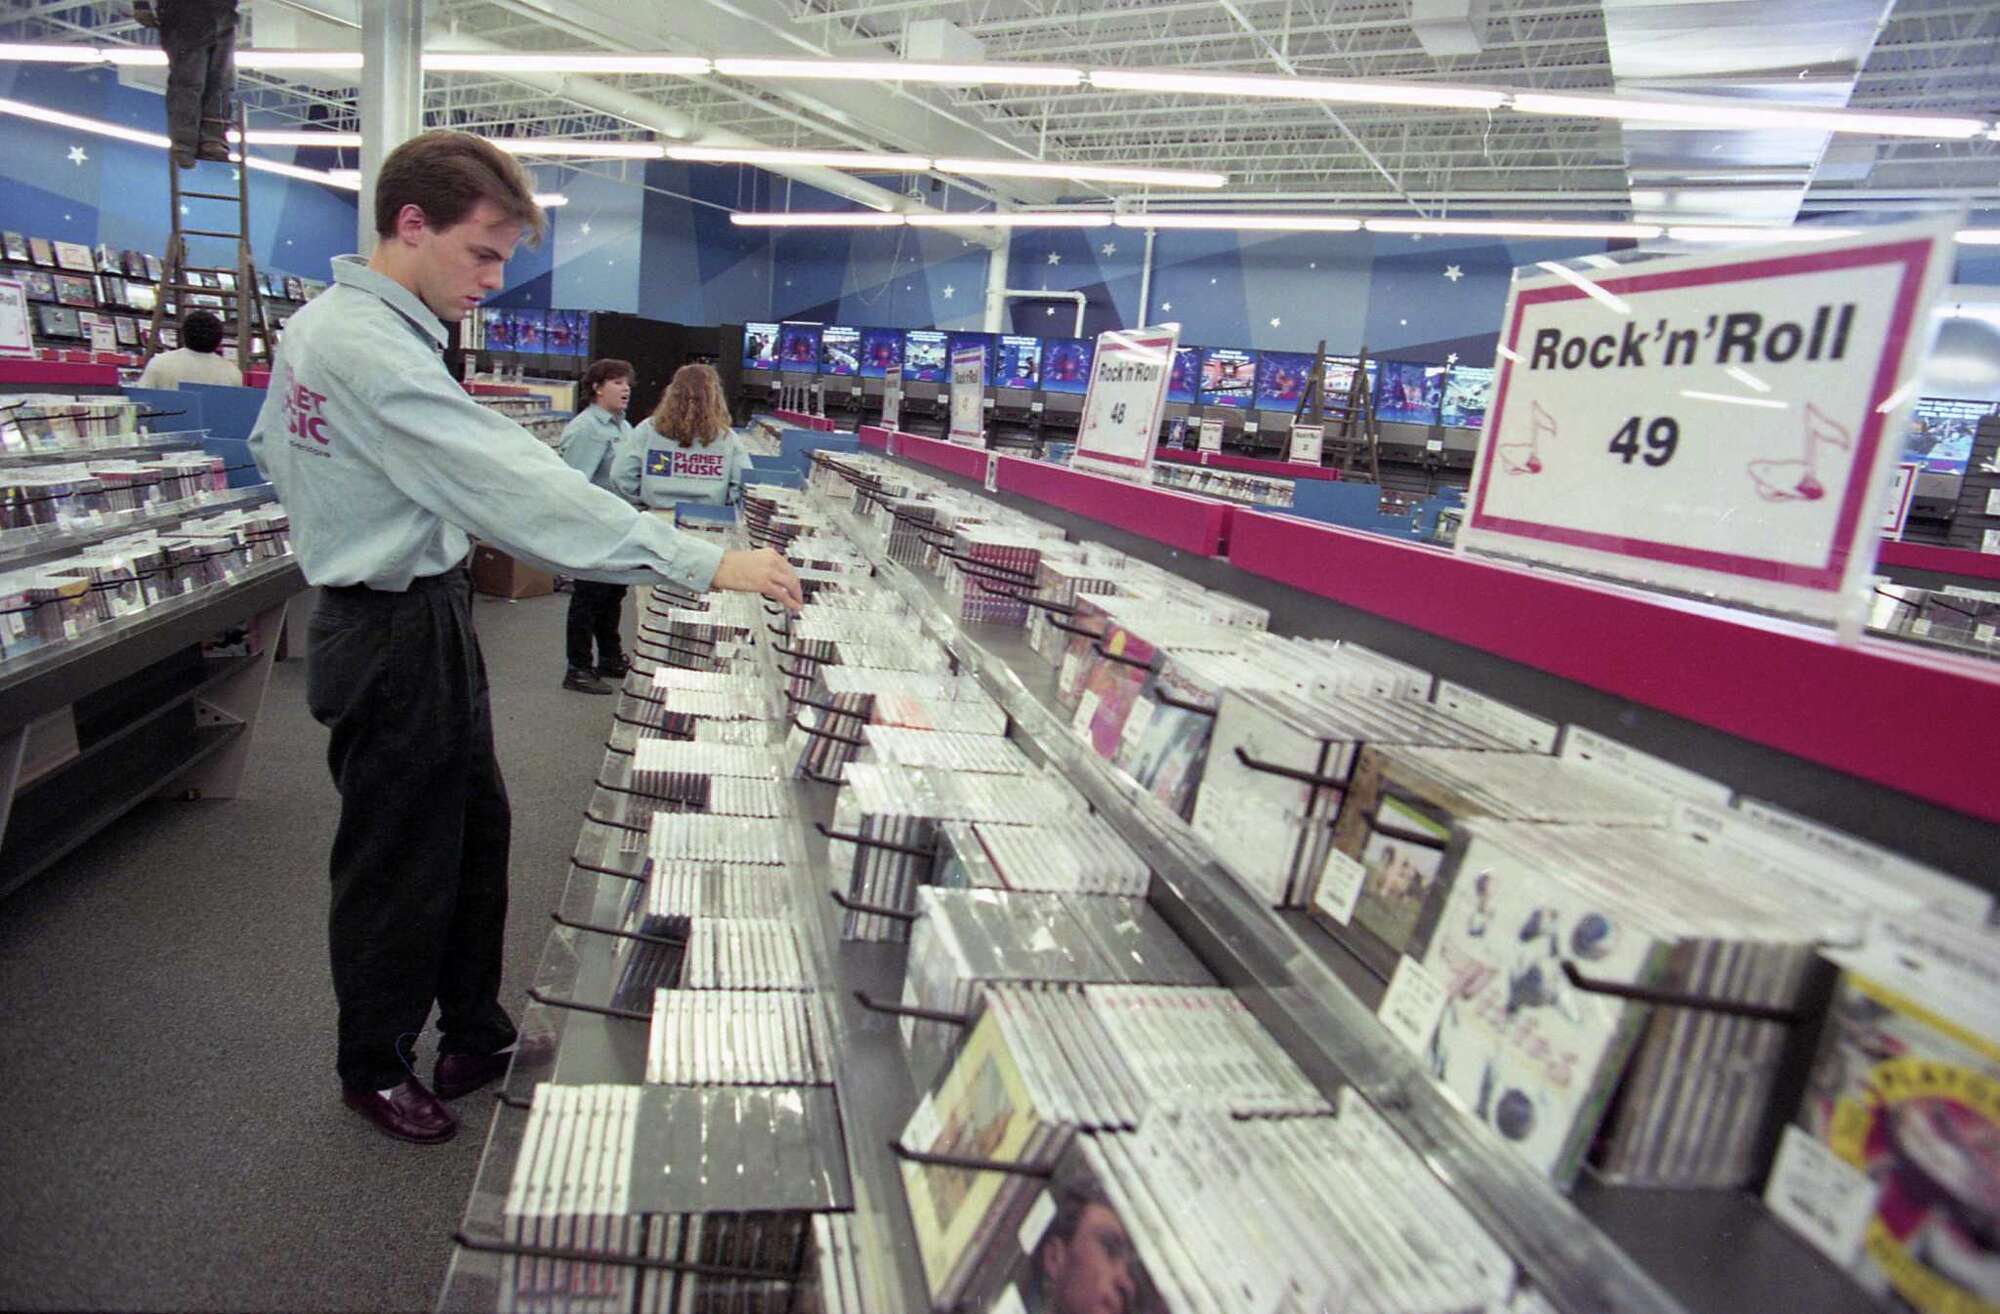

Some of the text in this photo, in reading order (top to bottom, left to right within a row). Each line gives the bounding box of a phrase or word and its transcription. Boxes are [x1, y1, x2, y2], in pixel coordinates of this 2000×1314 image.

[1530, 303, 1856, 371] Rock'n'Roll
[674, 451, 724, 464] PLANET
[1609, 416, 1680, 467] 49
[674, 462, 723, 476] MUSIC
